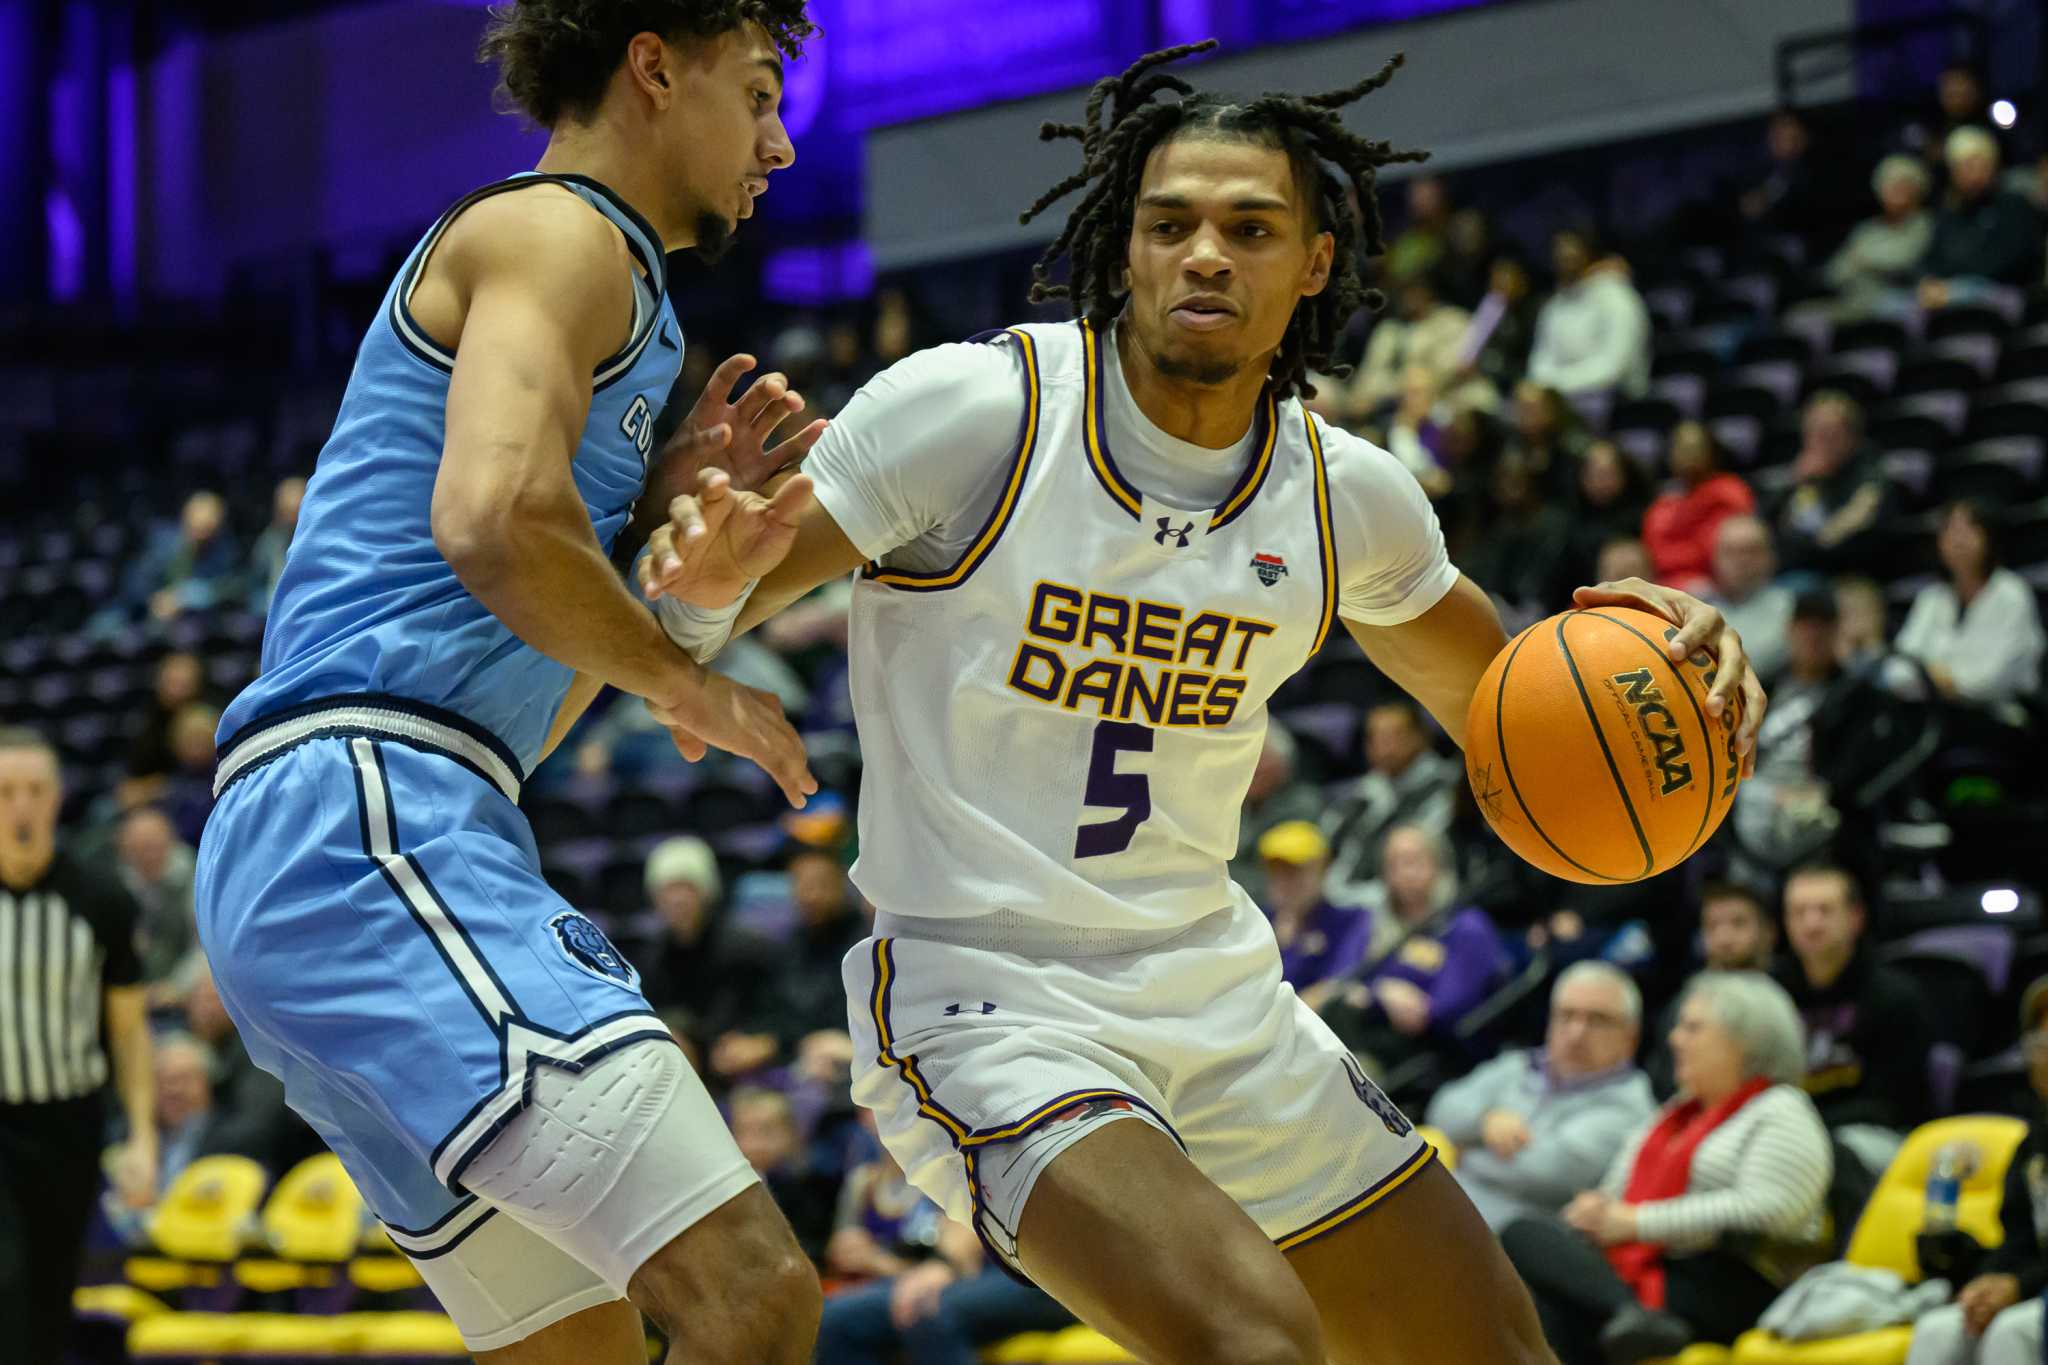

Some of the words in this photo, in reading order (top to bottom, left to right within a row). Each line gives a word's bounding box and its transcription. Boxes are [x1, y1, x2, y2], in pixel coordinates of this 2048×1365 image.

[1249, 558, 1288, 577] AMERICA
[1257, 567, 1280, 580] EAST
[1024, 578, 1280, 672] GREAT
[1006, 640, 1249, 729] DANES
[1602, 678, 1633, 729] OFFICIAL
[1611, 667, 1693, 797] NCAA
[1074, 720, 1154, 859] 5
